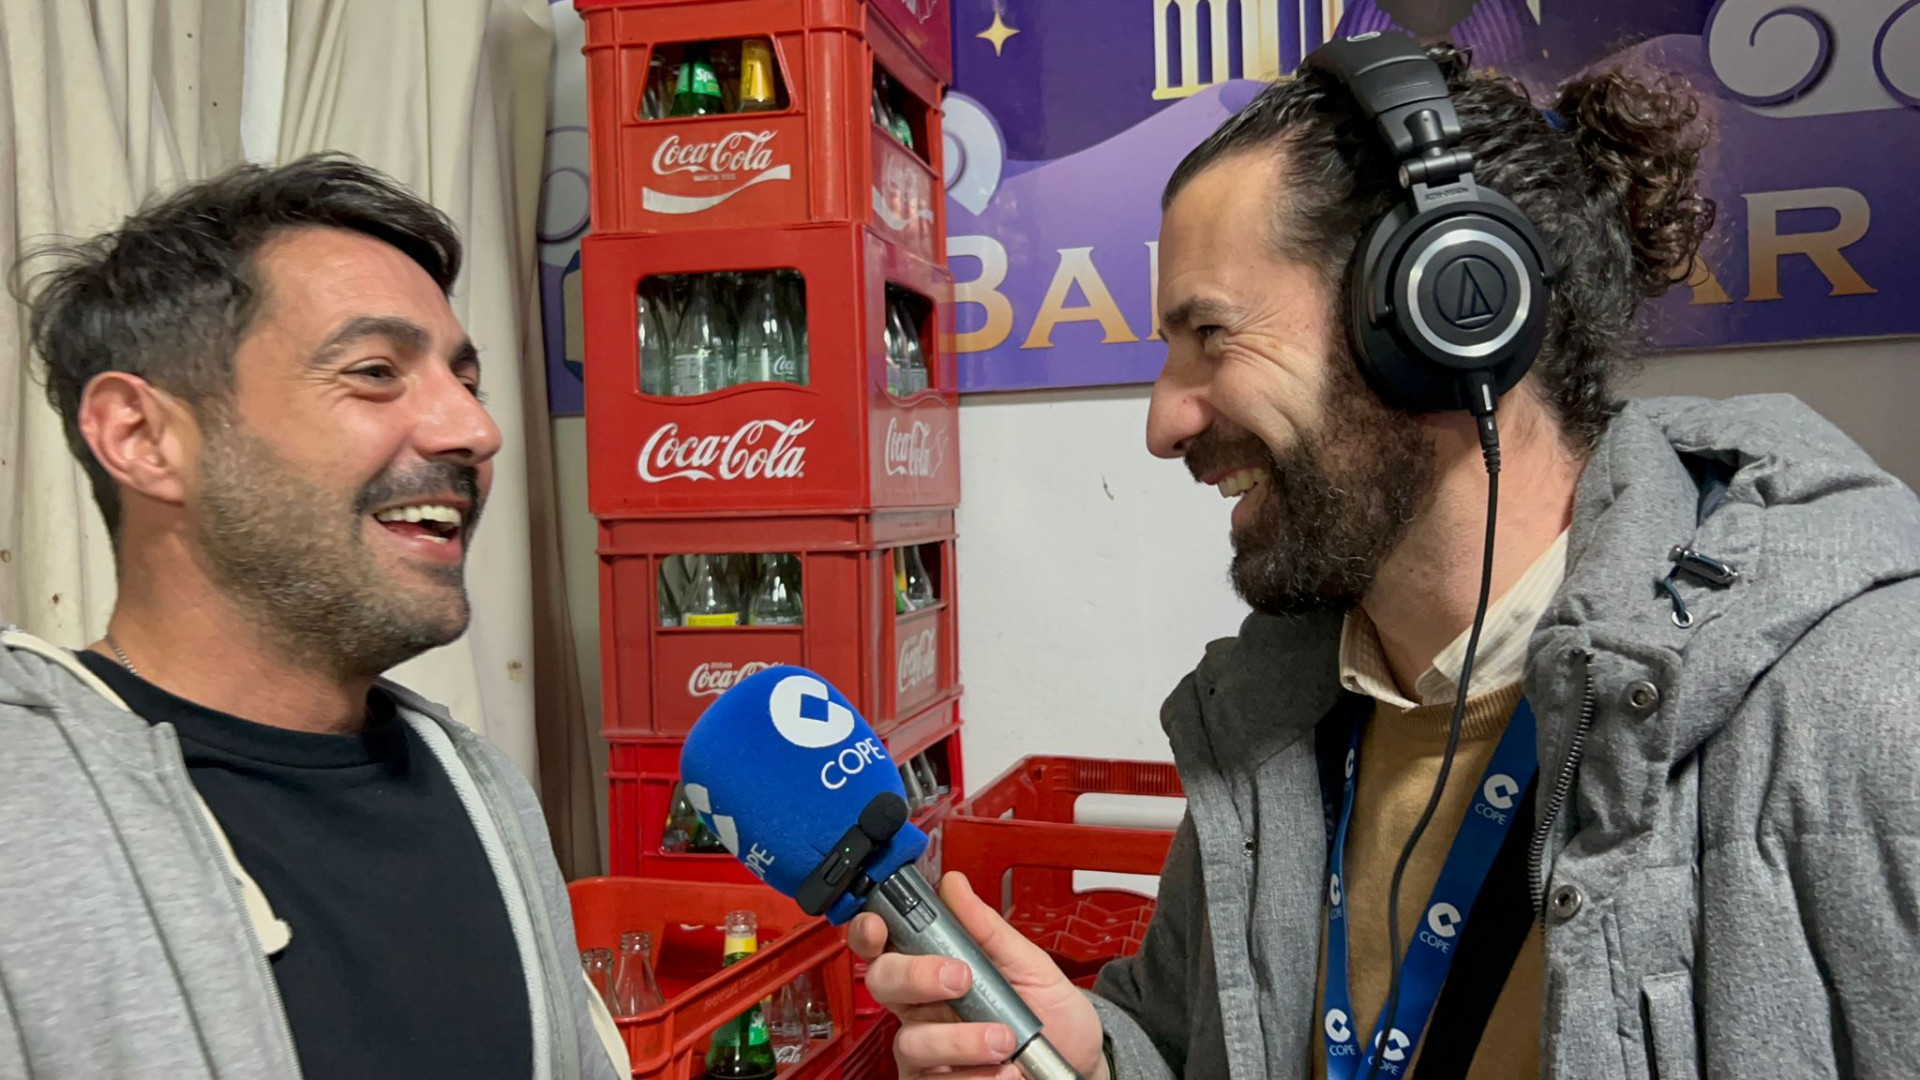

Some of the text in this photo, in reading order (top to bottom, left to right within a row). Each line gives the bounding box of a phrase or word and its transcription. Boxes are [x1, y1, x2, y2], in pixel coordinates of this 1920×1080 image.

[652, 130, 778, 176] Coca-Cola
[638, 418, 816, 483] Coca-Cola
[688, 661, 784, 697] Coca-C
[821, 737, 886, 790] COPE
[1475, 803, 1507, 825] COPE
[1420, 931, 1450, 954] COPE
[1329, 1044, 1356, 1056] COPE
